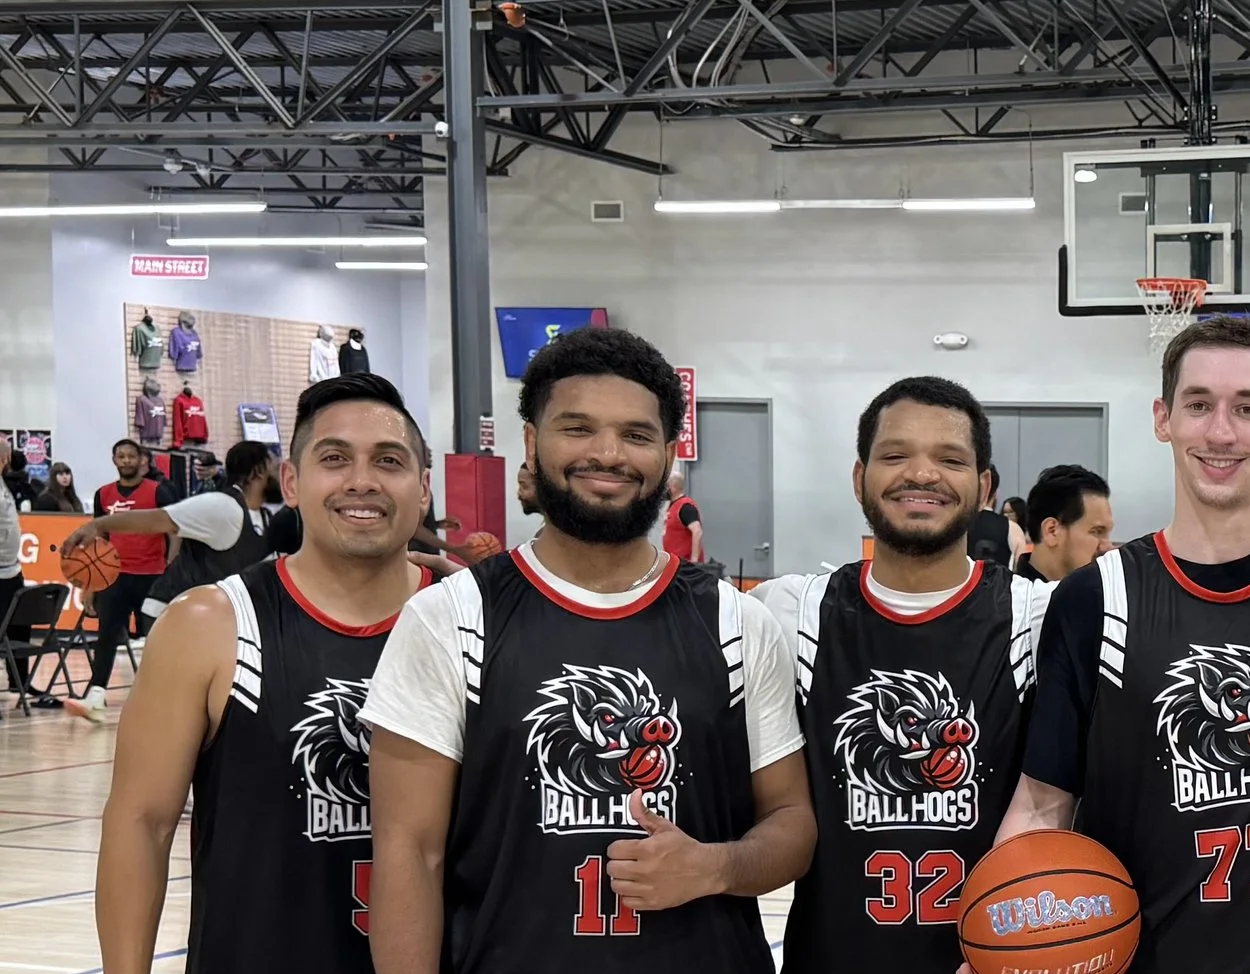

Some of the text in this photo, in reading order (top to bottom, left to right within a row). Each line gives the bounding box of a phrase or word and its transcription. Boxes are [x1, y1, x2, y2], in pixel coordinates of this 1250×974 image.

[134, 259, 204, 274] MAIN STREET
[1177, 766, 1238, 804] BALL
[545, 788, 605, 826] BALL
[852, 789, 973, 824] BALL HOGS
[865, 850, 965, 925] 32
[987, 890, 1114, 937] Wilson
